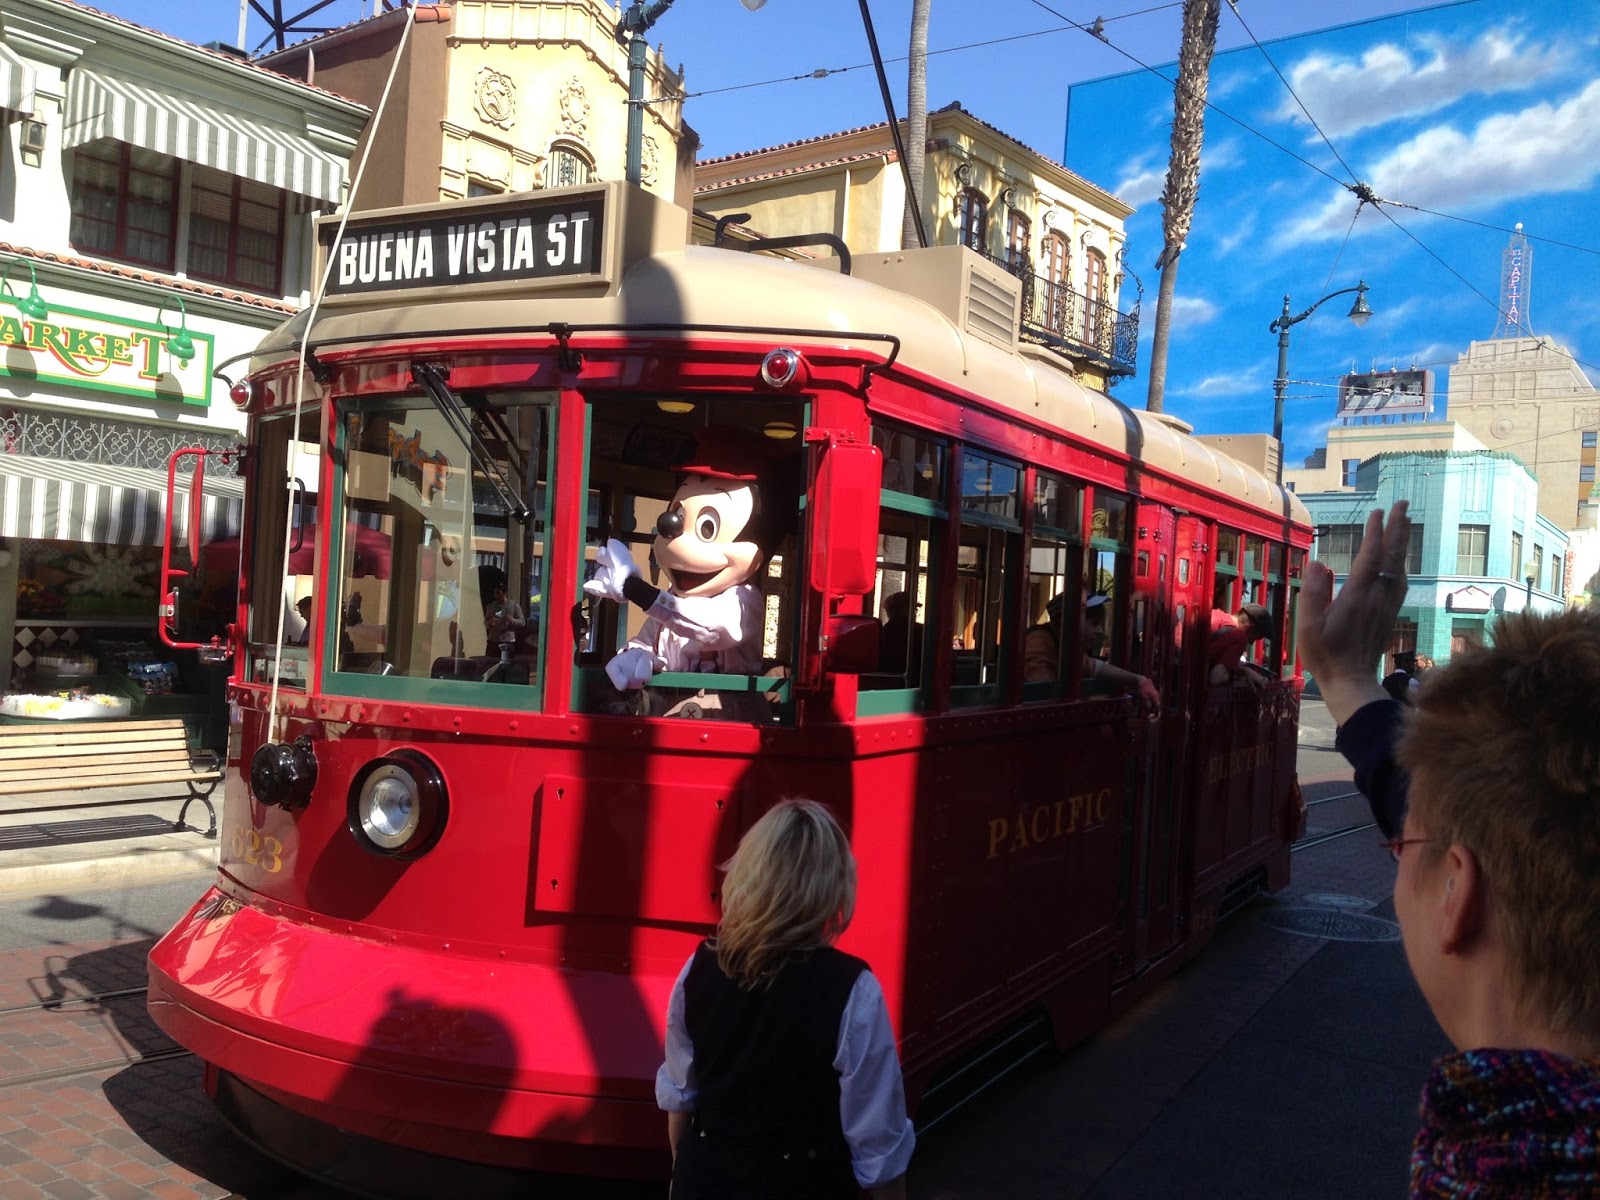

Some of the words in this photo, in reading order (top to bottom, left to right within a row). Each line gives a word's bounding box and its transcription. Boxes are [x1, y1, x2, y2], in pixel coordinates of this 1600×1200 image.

[339, 228, 434, 286] BUENA
[447, 217, 534, 276] VISTA
[546, 210, 590, 267] ST
[1507, 257, 1521, 325] CAPITAN
[985, 788, 1112, 860] PACIFIC
[1207, 744, 1273, 785] ELECTRIC
[231, 824, 283, 874] 623
